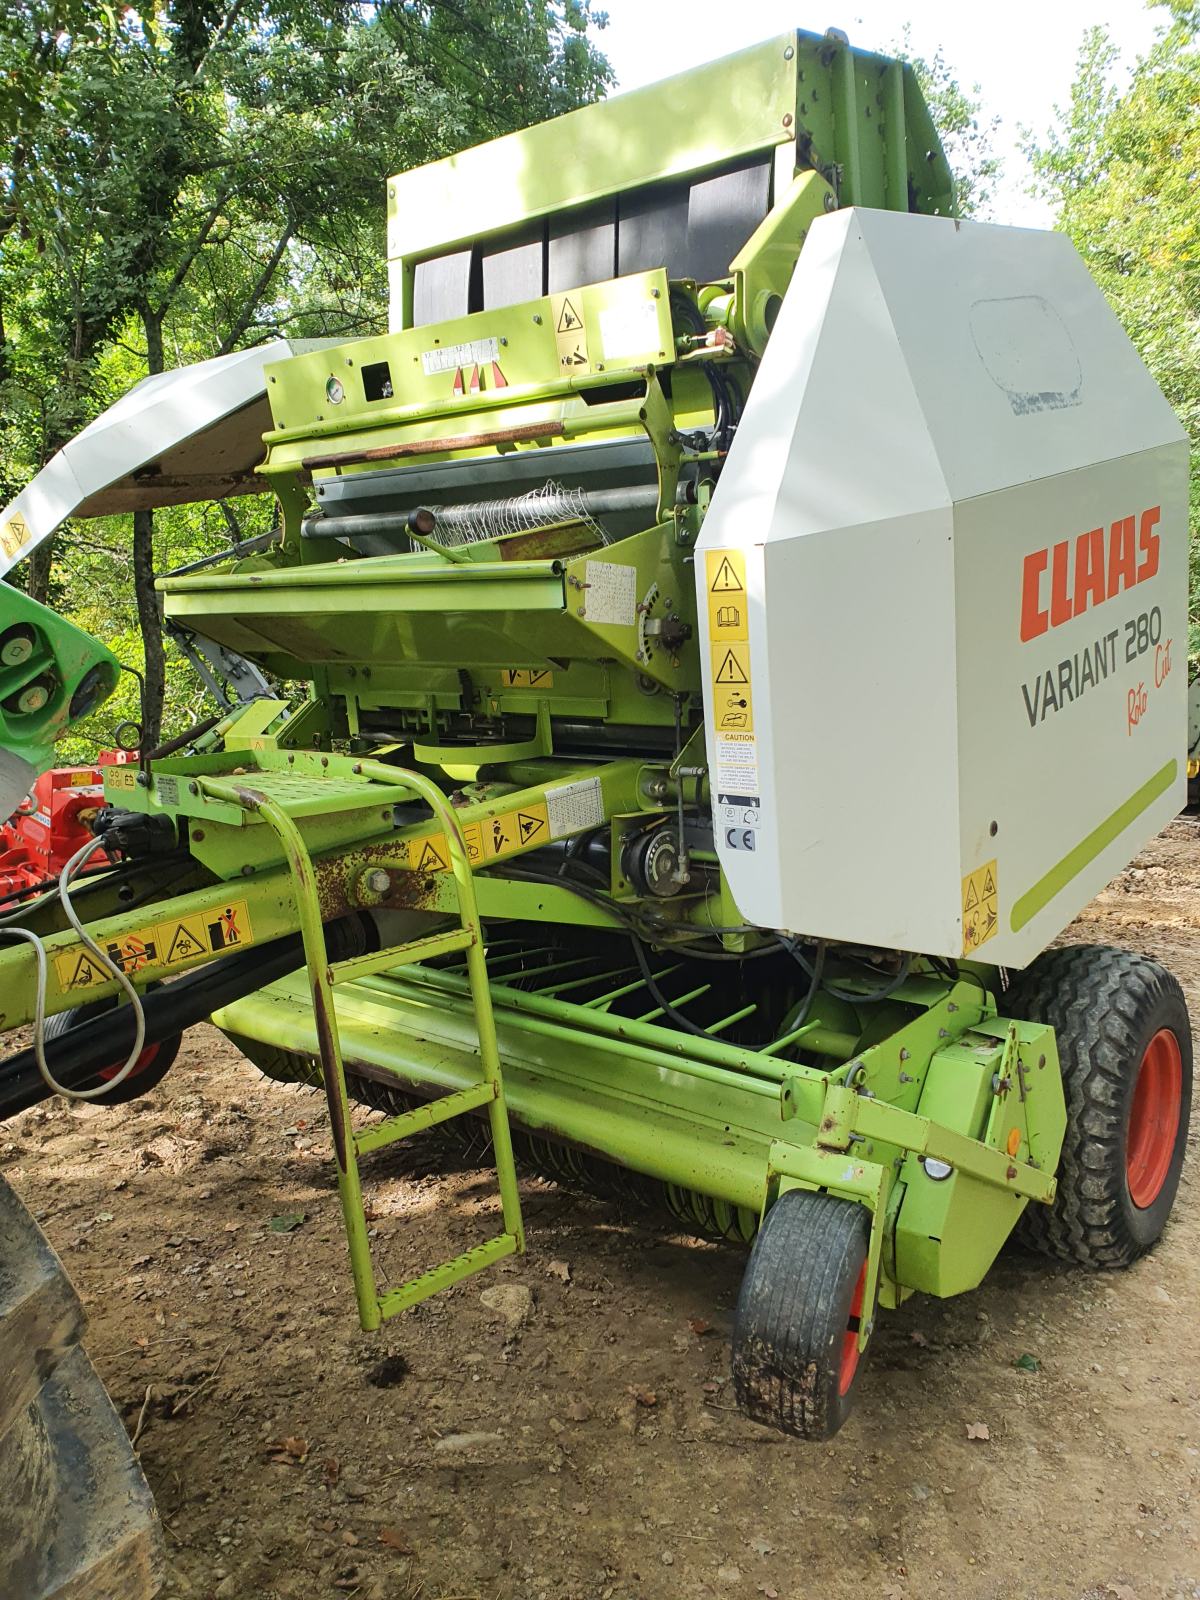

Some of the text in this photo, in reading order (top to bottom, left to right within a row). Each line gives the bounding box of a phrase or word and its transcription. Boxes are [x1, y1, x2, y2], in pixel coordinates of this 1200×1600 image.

[1020, 505, 1161, 643] CLAAS
[1021, 605, 1162, 728] VARIANT 280
[1127, 638, 1173, 737] Roto Cut
[724, 733, 755, 741] CAUTION
